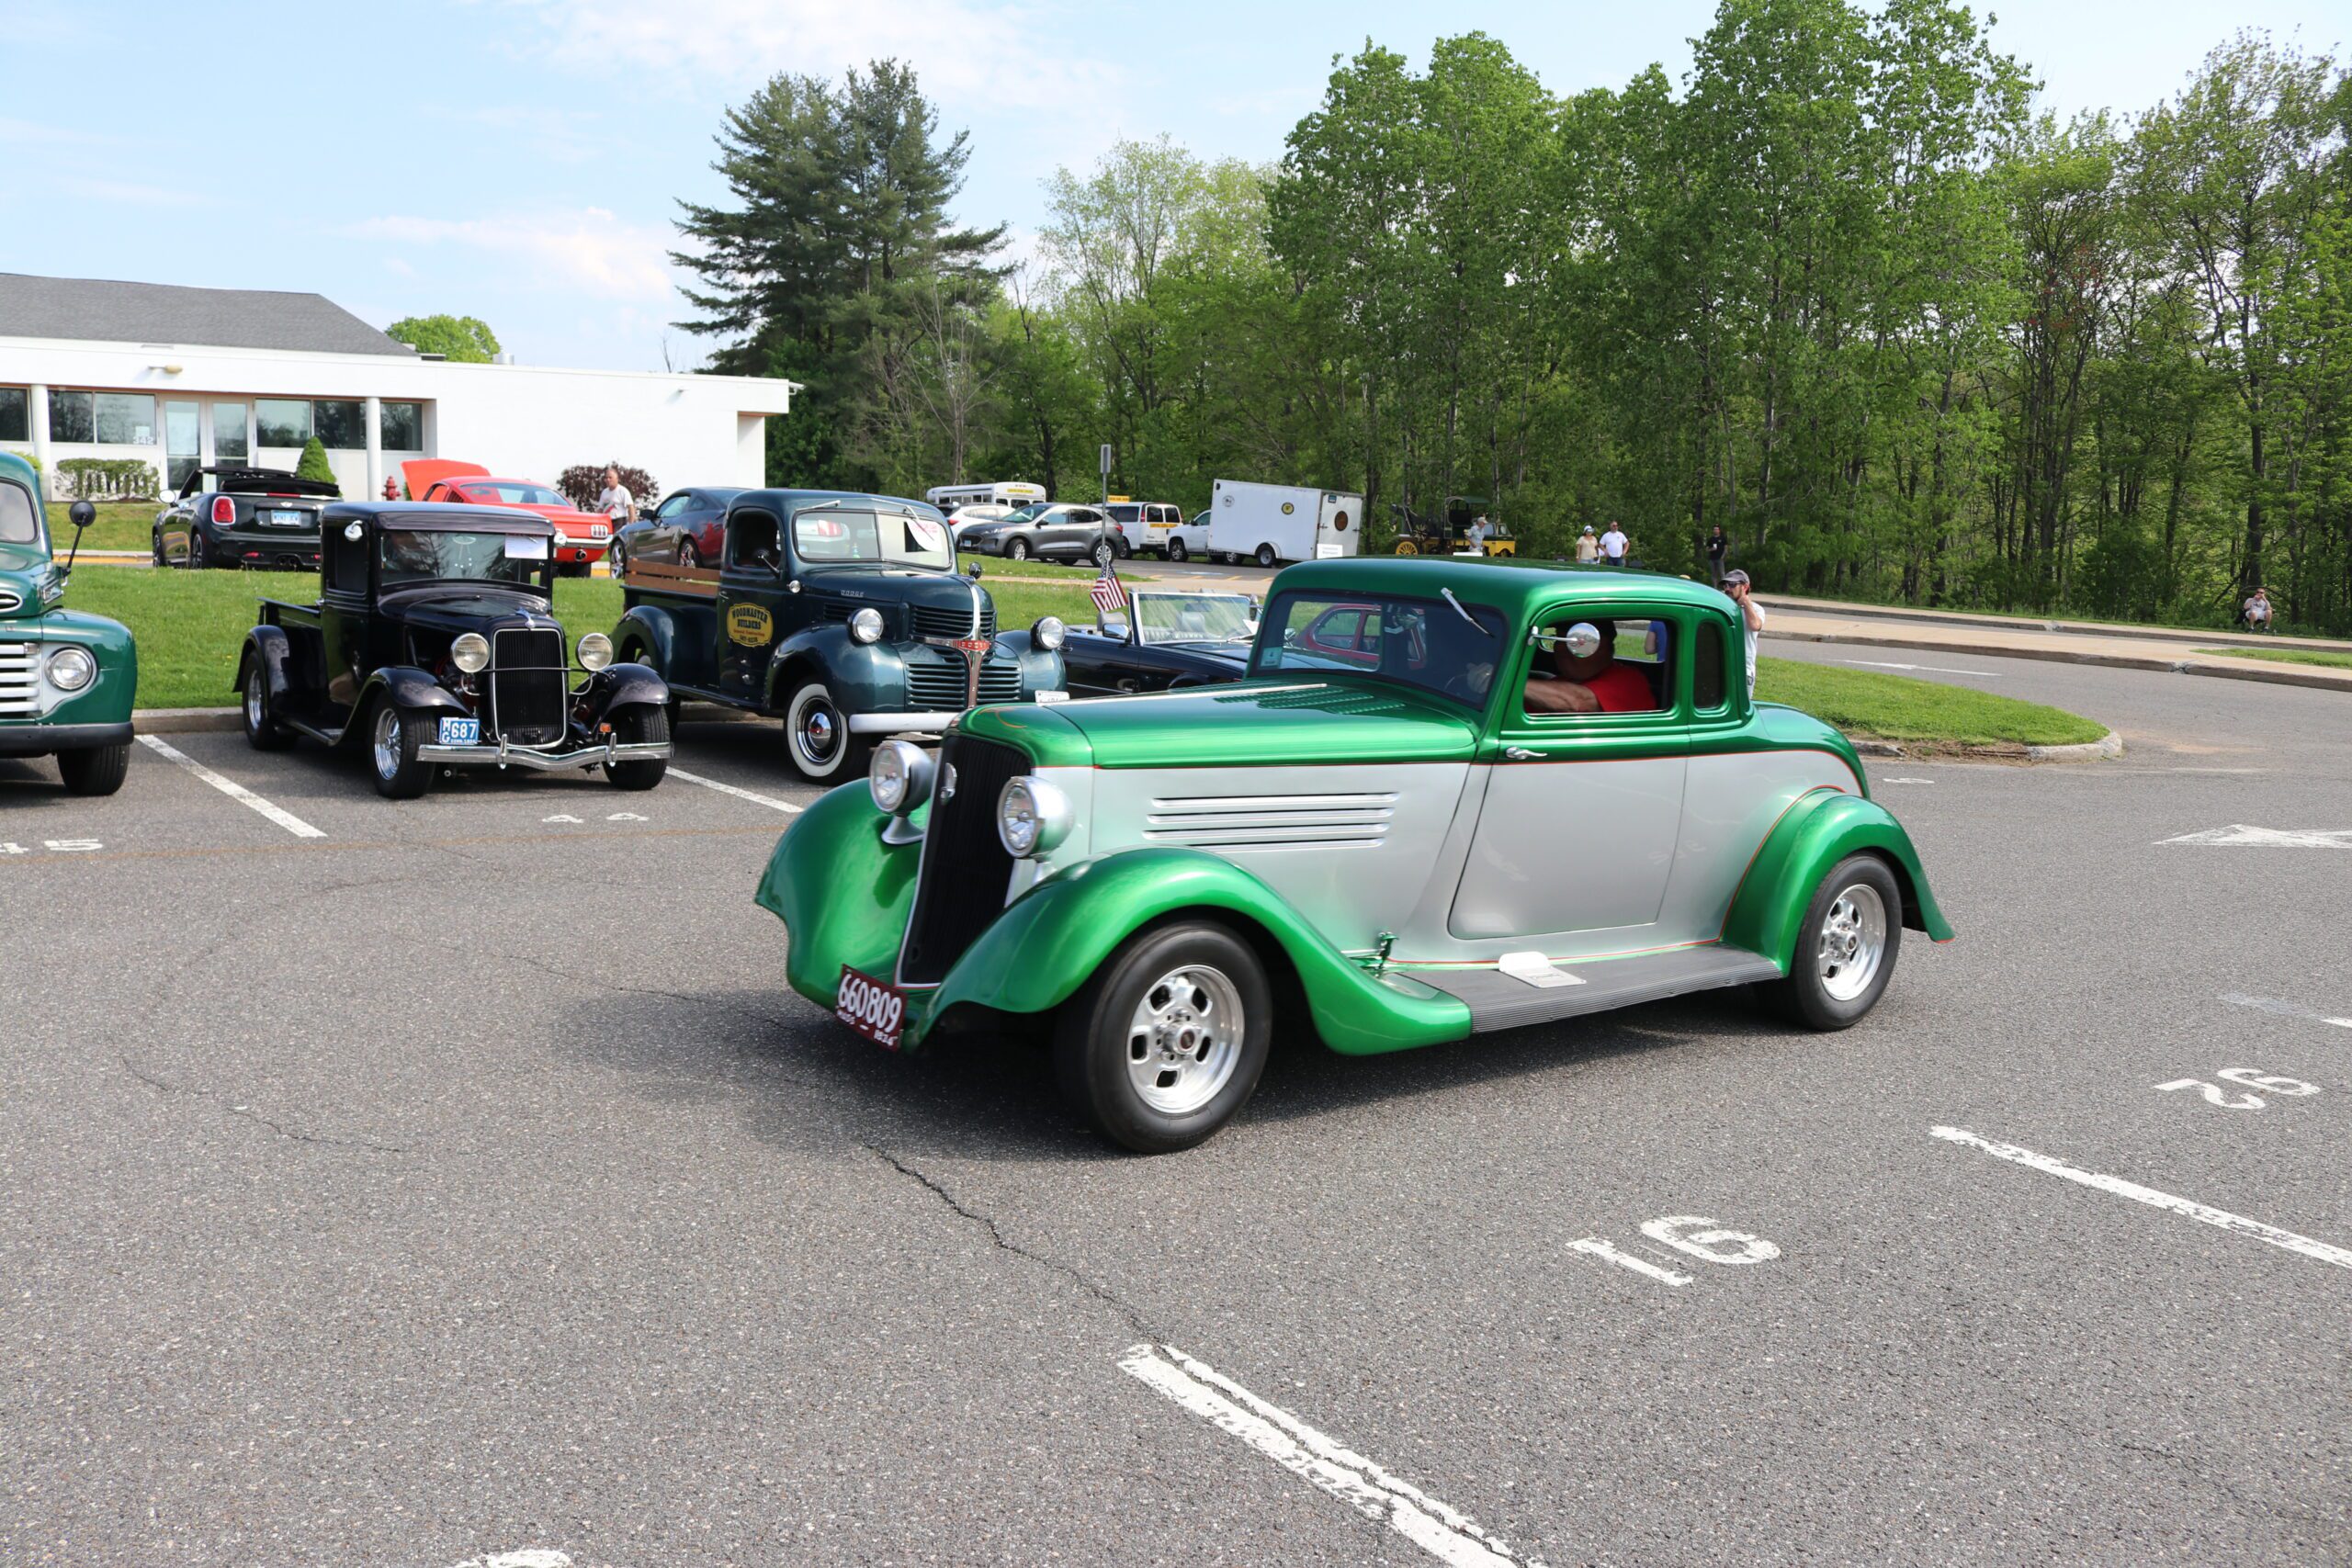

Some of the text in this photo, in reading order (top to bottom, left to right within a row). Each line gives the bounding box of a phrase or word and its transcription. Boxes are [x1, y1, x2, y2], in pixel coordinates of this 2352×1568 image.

[132, 435, 154, 446] 342
[451, 722, 477, 739] 687
[838, 974, 902, 1032] 660809
